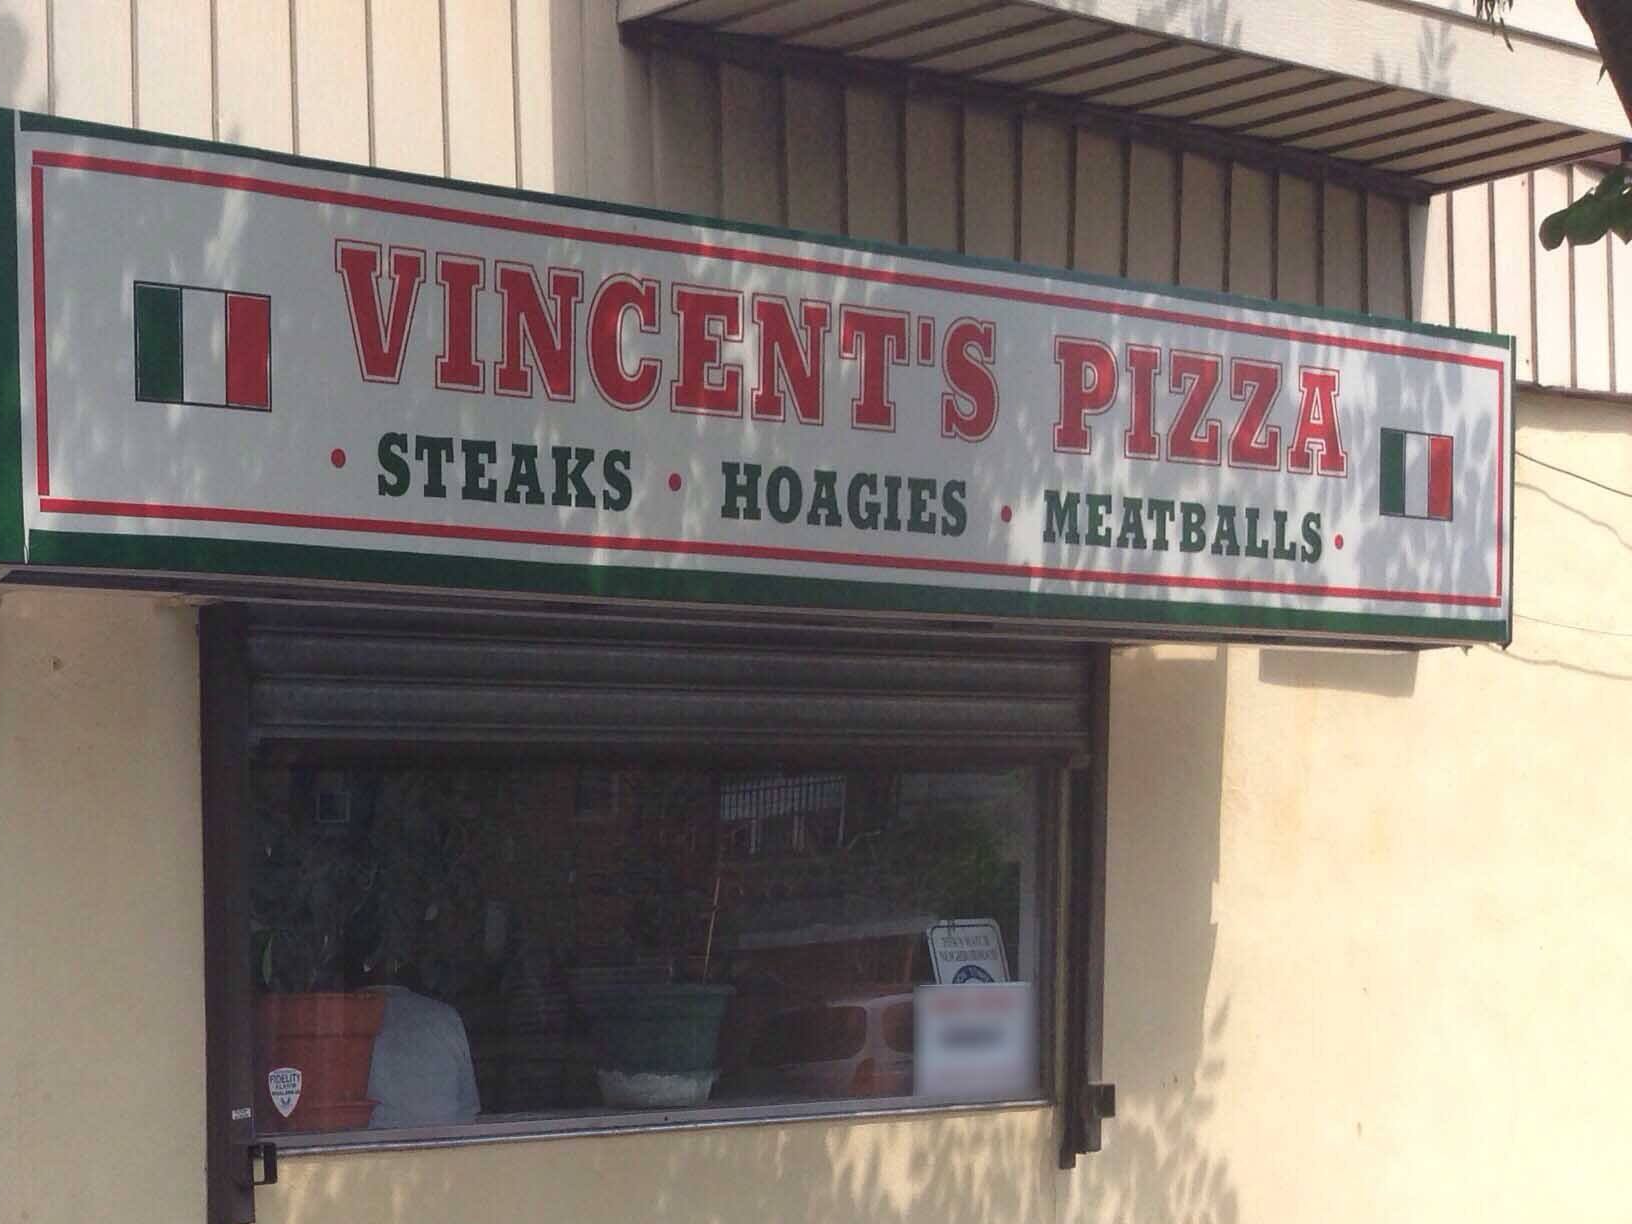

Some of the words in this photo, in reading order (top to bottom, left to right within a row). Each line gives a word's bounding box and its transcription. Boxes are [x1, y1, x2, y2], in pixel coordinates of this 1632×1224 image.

[333, 238, 1001, 444] VINCENT'S
[1050, 336, 1350, 478] PIZZA
[377, 432, 633, 513] STEAKS
[721, 459, 970, 539] HOAGIES
[1042, 489, 1324, 564] MEATBALLS
